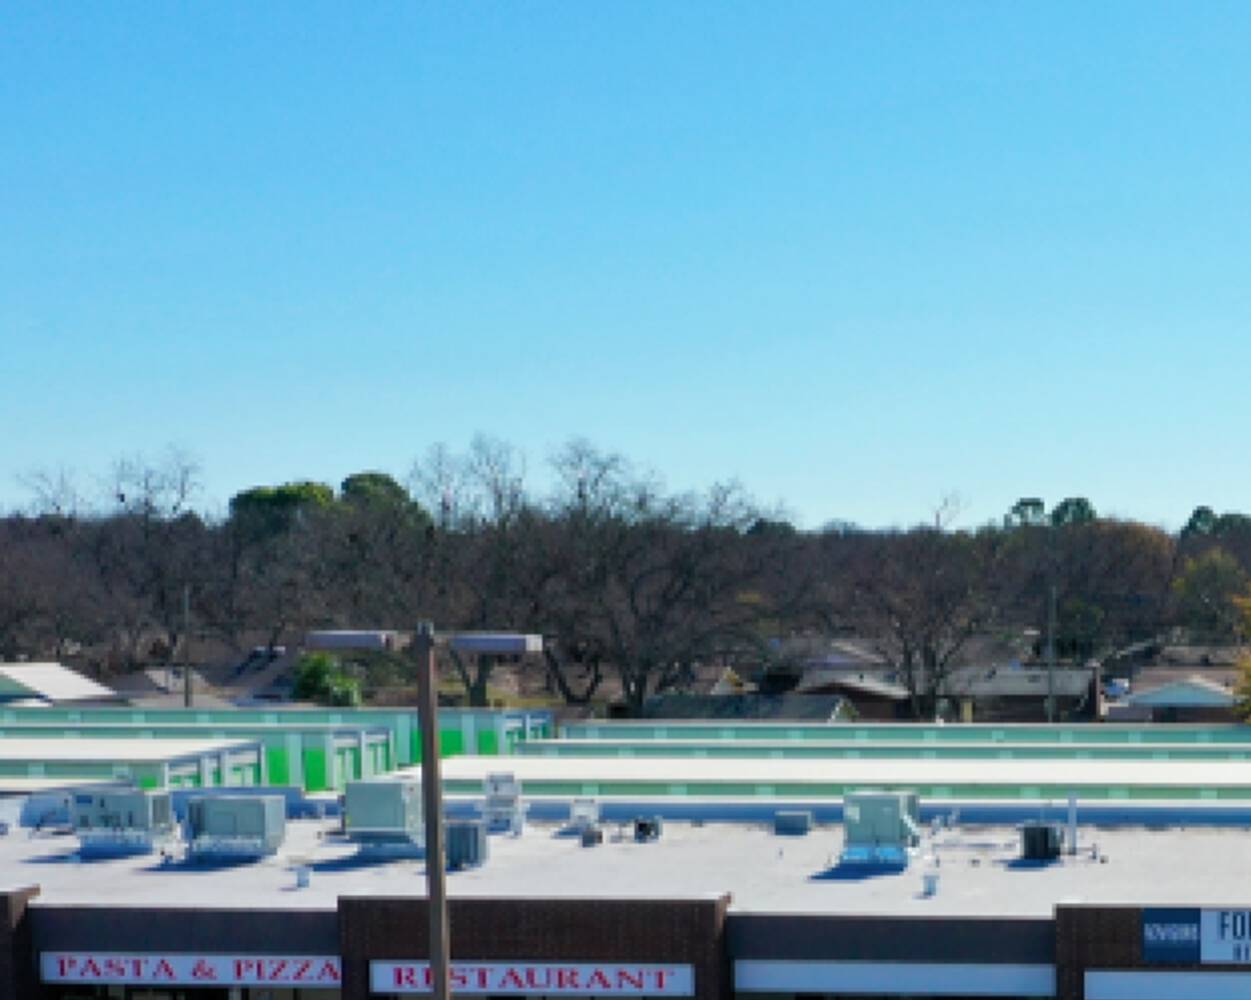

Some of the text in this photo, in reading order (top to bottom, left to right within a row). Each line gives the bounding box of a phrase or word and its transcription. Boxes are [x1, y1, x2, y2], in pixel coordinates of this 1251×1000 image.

[57, 958, 342, 981] PASTA & PIZZA
